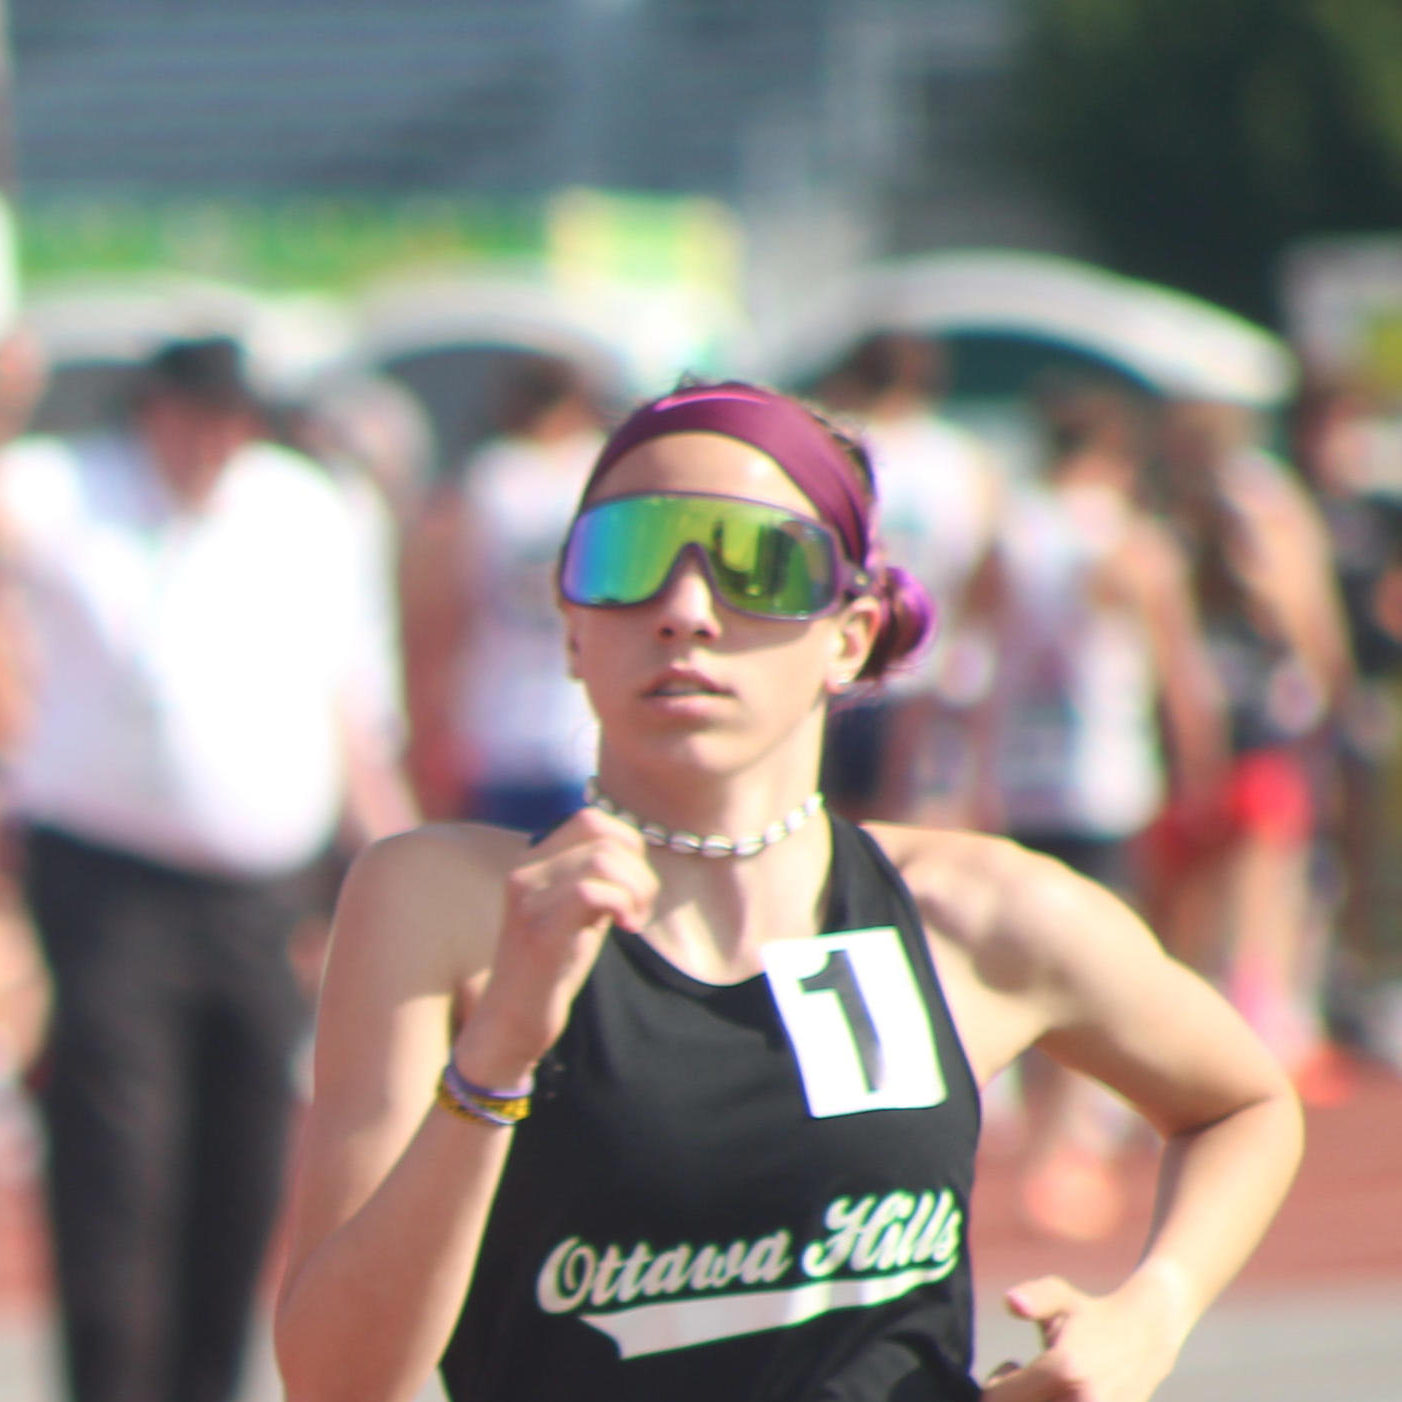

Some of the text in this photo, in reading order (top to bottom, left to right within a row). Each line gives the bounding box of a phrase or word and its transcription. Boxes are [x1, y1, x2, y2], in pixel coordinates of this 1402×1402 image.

[796, 947, 886, 1096] 1
[535, 1188, 963, 1317] Ottawa Hills
